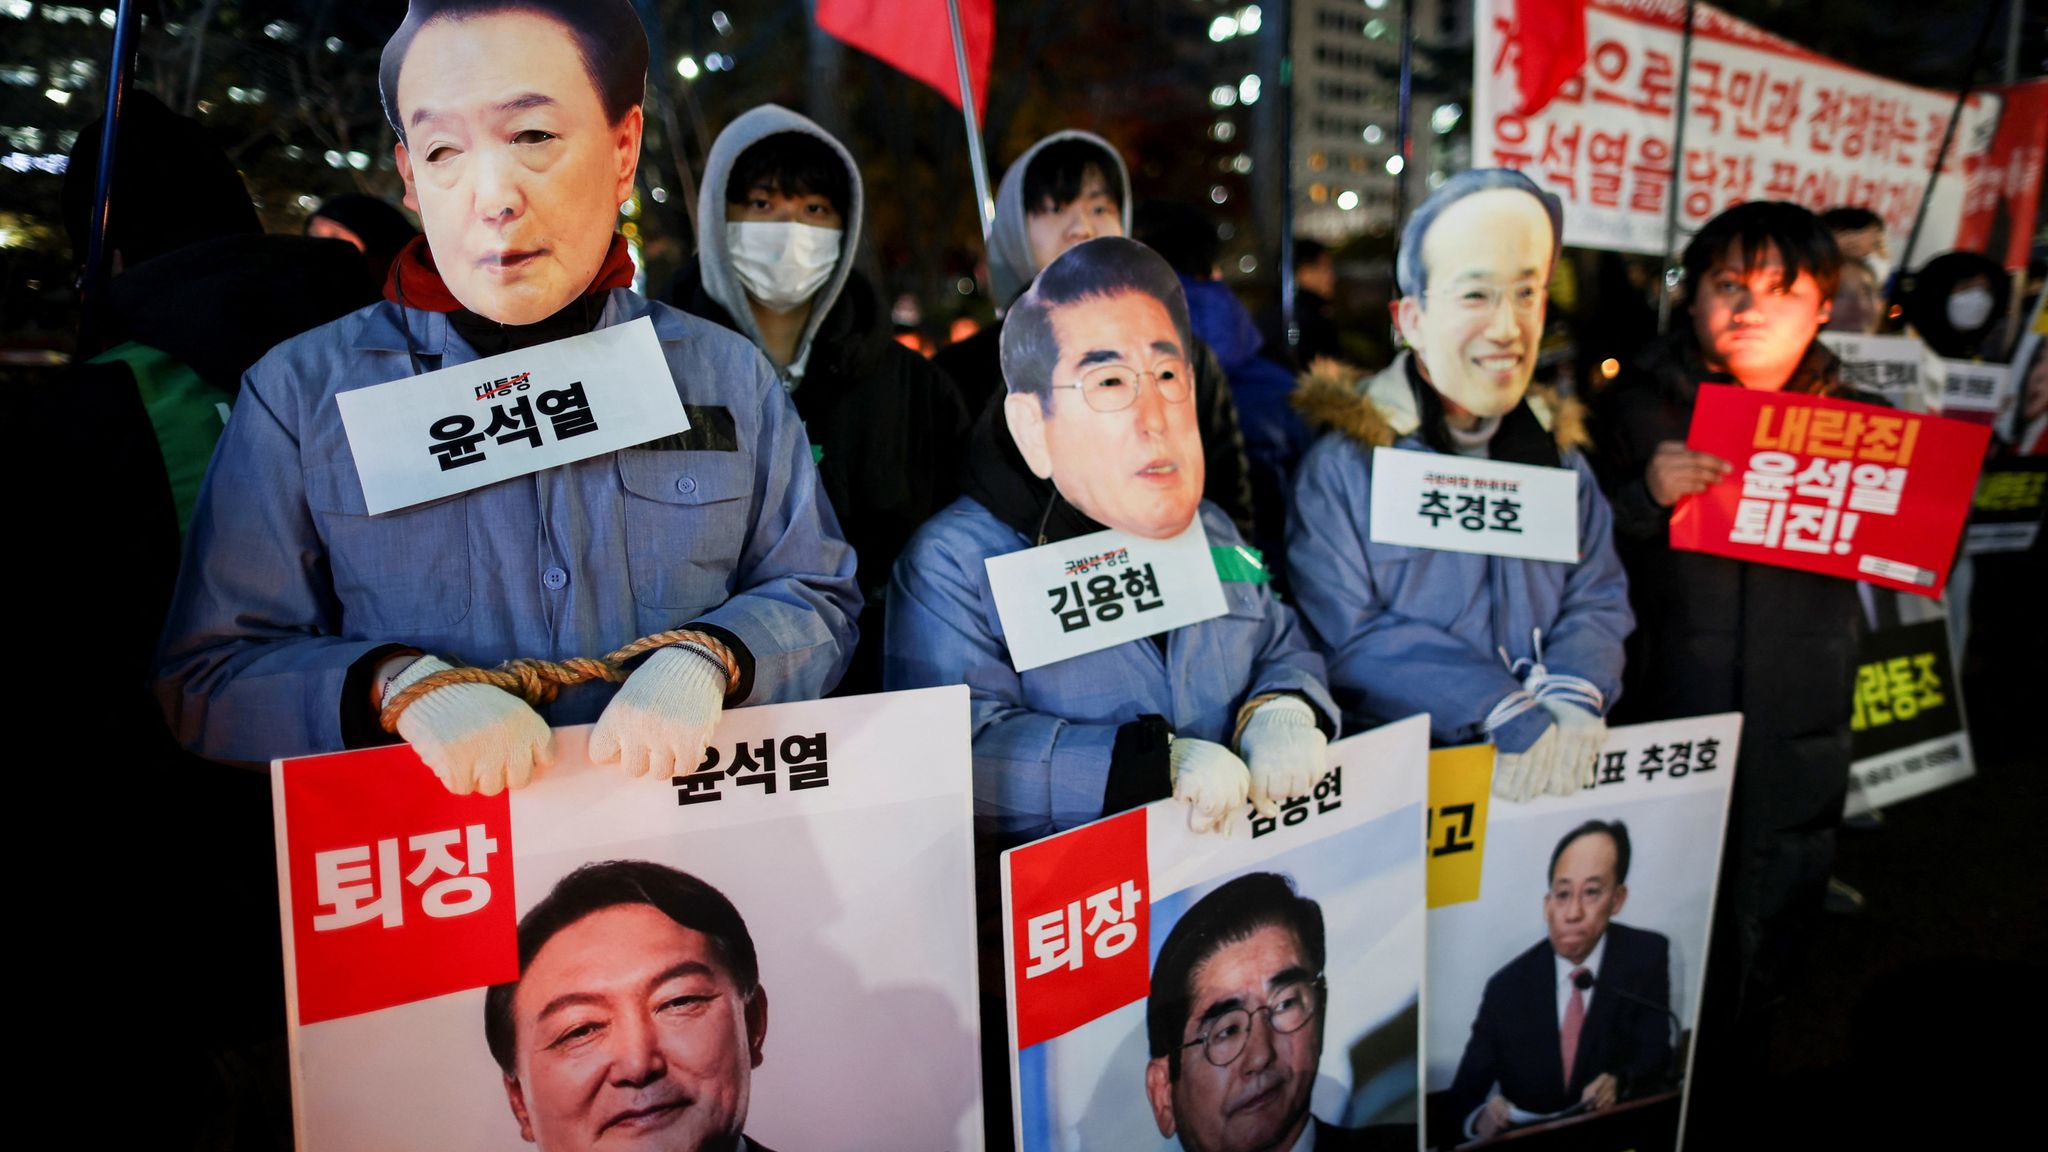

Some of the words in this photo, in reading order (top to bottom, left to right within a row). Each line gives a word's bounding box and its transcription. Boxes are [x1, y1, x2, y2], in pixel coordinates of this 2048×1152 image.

[1688, 60, 1802, 142] 국민과
[1808, 88, 1917, 166] 전쟁하는
[1493, 113, 1676, 213] 윤석열을
[1685, 150, 1756, 217] 당장
[474, 371, 530, 401] 대통령
[428, 381, 599, 471] 윤석열
[1752, 404, 1922, 467] 내란죄
[1418, 490, 1523, 533] 추경호
[1742, 451, 1907, 515] 윤석열
[1729, 499, 1860, 555] 퇴진!
[1065, 555, 1102, 575] 국방부
[1103, 548, 1130, 567] 장관
[1047, 562, 1164, 633] 김용현
[672, 732, 829, 806] 윤석열
[1638, 738, 1720, 781] 추경호
[1427, 802, 1475, 858] 고
[313, 824, 498, 932] 퇴장
[1026, 880, 1142, 979] 퇴장
